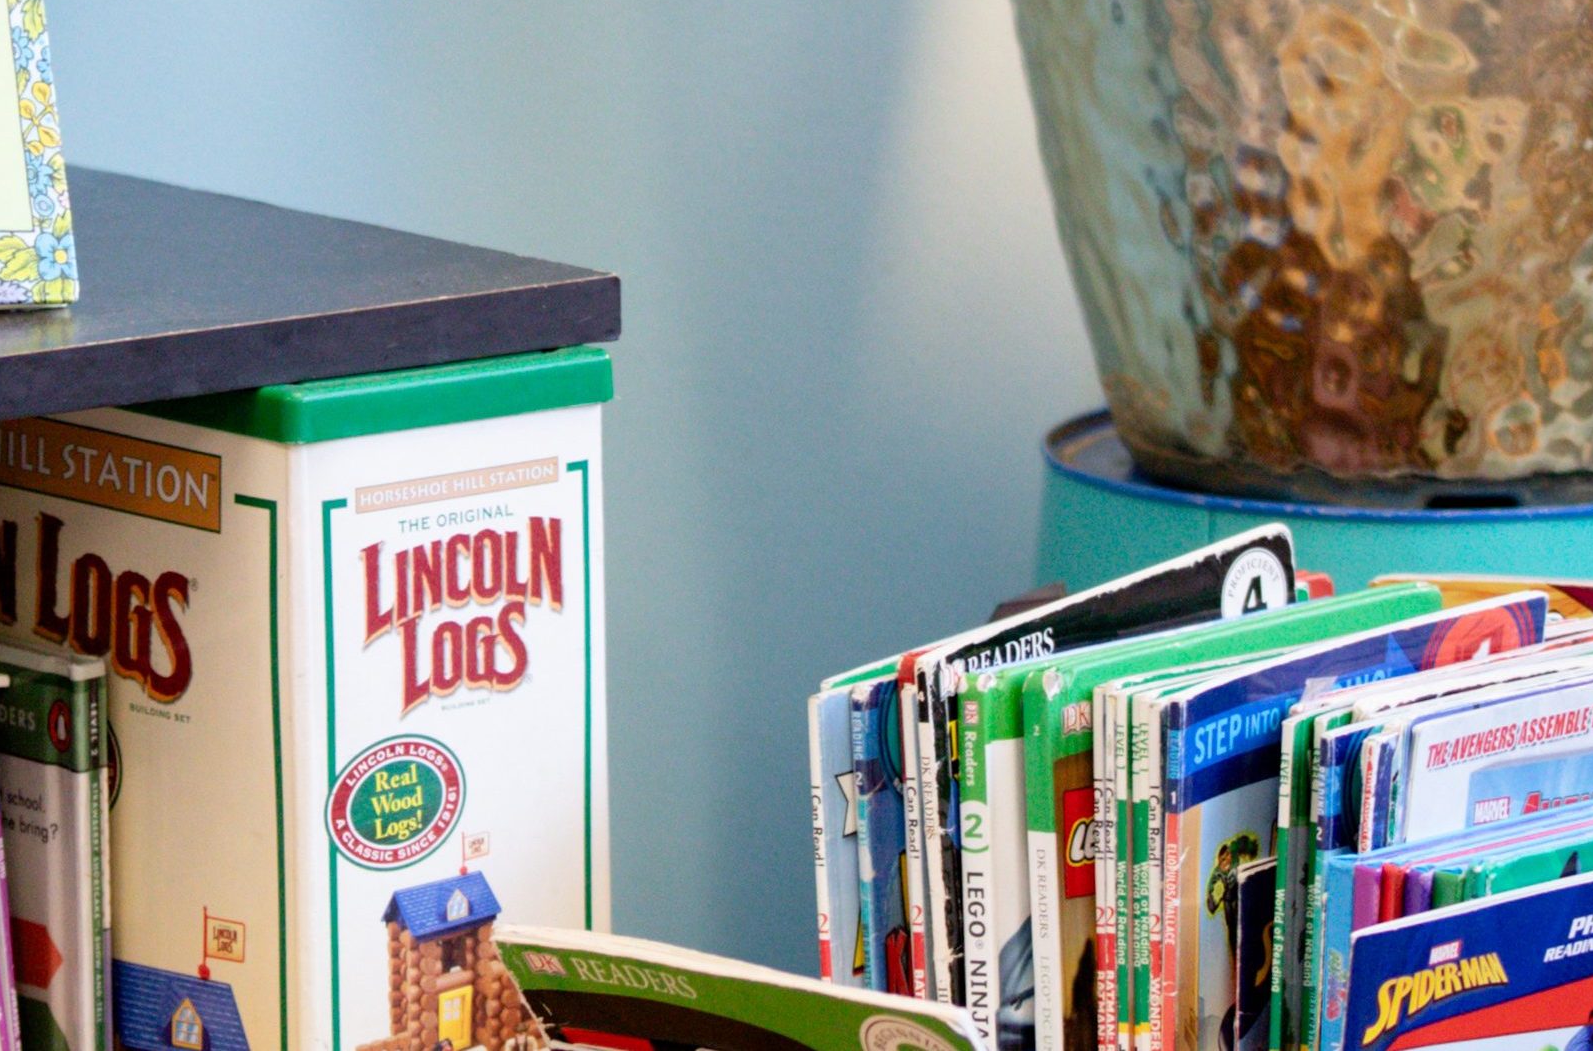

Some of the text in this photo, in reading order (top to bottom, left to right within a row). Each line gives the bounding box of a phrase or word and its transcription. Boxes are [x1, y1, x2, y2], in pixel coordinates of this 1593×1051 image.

[62, 443, 215, 510] STATION
[360, 463, 555, 508] HORSESHOE HILL STATION
[398, 505, 514, 534] THE ORIGINAL
[360, 516, 562, 650] LINCOLN
[1228, 550, 1281, 598] PROFICIENT
[1243, 575, 1267, 613] 4
[33, 512, 193, 704] LOGS
[397, 601, 528, 720] LOGS
[967, 627, 1055, 672] READERS
[964, 701, 979, 725] DK
[964, 730, 977, 787] Readers
[1194, 708, 1281, 766] STEP INTO
[1426, 744, 1449, 770] THE
[1449, 722, 1517, 764] AVENGERS
[1517, 708, 1589, 745] ASSEMBLE
[345, 744, 404, 787] LINCOLN
[375, 762, 418, 793] Real
[371, 785, 423, 815] Wood
[1474, 797, 1510, 824] MARVEL
[19, 818, 58, 843] bring?
[336, 819, 346, 830] A
[342, 832, 394, 862] CLASSIC
[398, 830, 437, 859] SINCE
[375, 810, 423, 840] Logs!
[907, 786, 917, 814] Can
[913, 905, 923, 926] 2
[967, 871, 986, 939] LEGO
[1271, 889, 1285, 993] World of Reading
[1429, 940, 1461, 965] MARVEL
[527, 954, 698, 1000] DK READERS
[970, 960, 989, 1037] NINJA
[1362, 951, 1509, 1047] SPIDER-MAN
